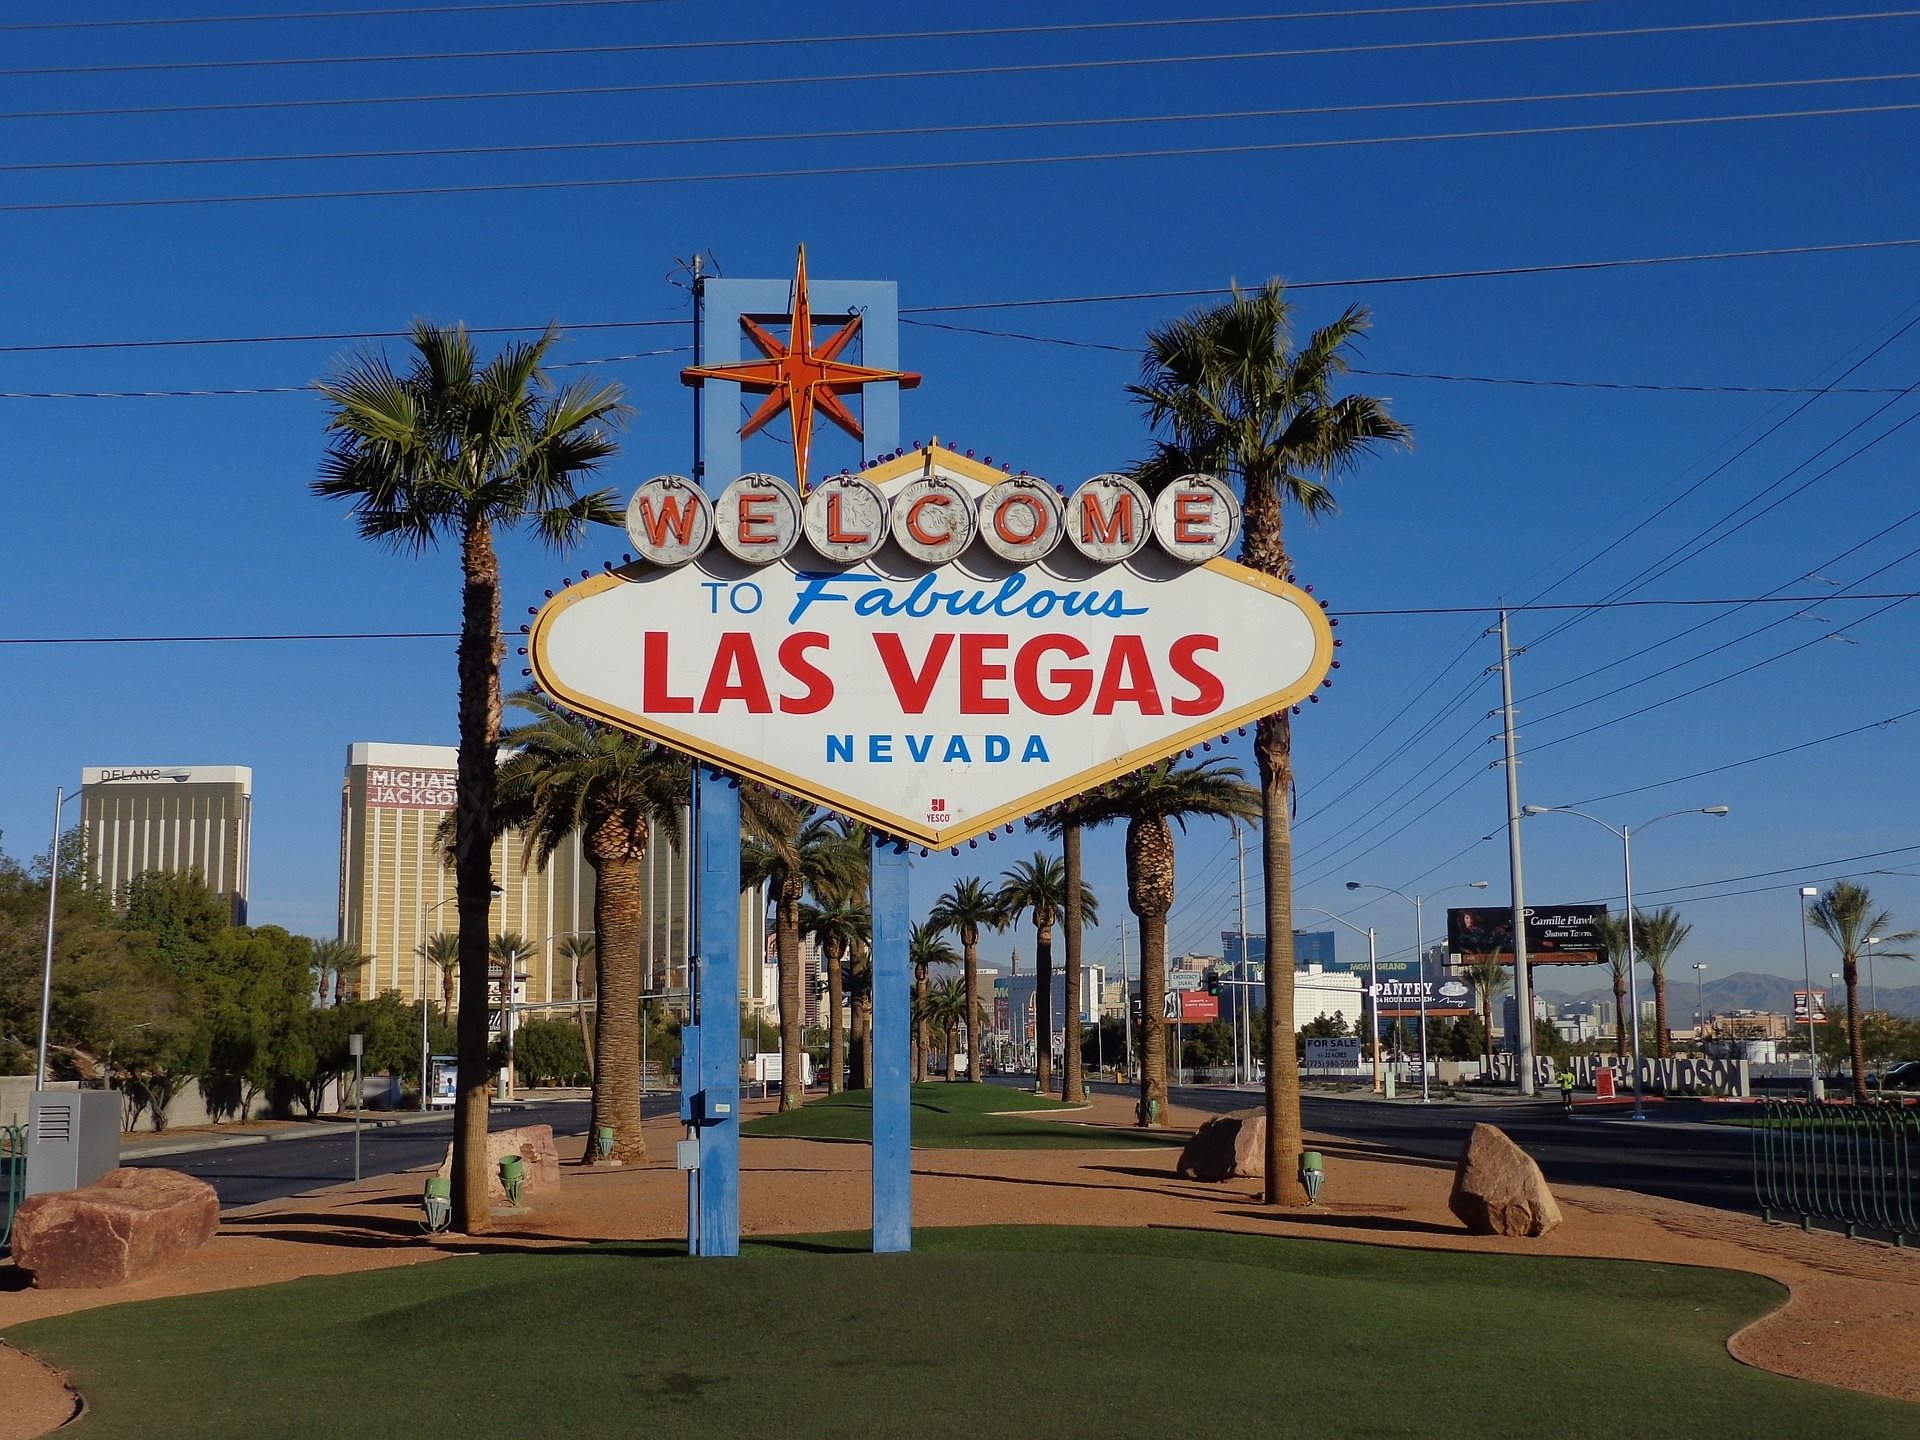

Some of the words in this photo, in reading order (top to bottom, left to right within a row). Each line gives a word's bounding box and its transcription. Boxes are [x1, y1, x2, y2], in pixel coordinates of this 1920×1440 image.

[639, 492, 1216, 547] WELCOME
[701, 582, 763, 614] TO
[788, 572, 1150, 625] Fabulous
[643, 631, 835, 715] LAS
[872, 633, 1226, 717] VEGAS
[826, 734, 1051, 763] NEVADA
[101, 769, 161, 781] DELANO
[372, 770, 459, 789] MICHAE
[372, 787, 459, 806] JACKSO
[926, 813, 951, 823] YESCO
[1531, 915, 1566, 926] Camille
[1567, 914, 1597, 925] Flawle
[1544, 929, 1569, 938] Shawn
[1377, 963, 1407, 971] GRAND
[1375, 982, 1433, 996] PANTRY
[1307, 1040, 1328, 1048] FOR
[1330, 1040, 1357, 1048] SALE
